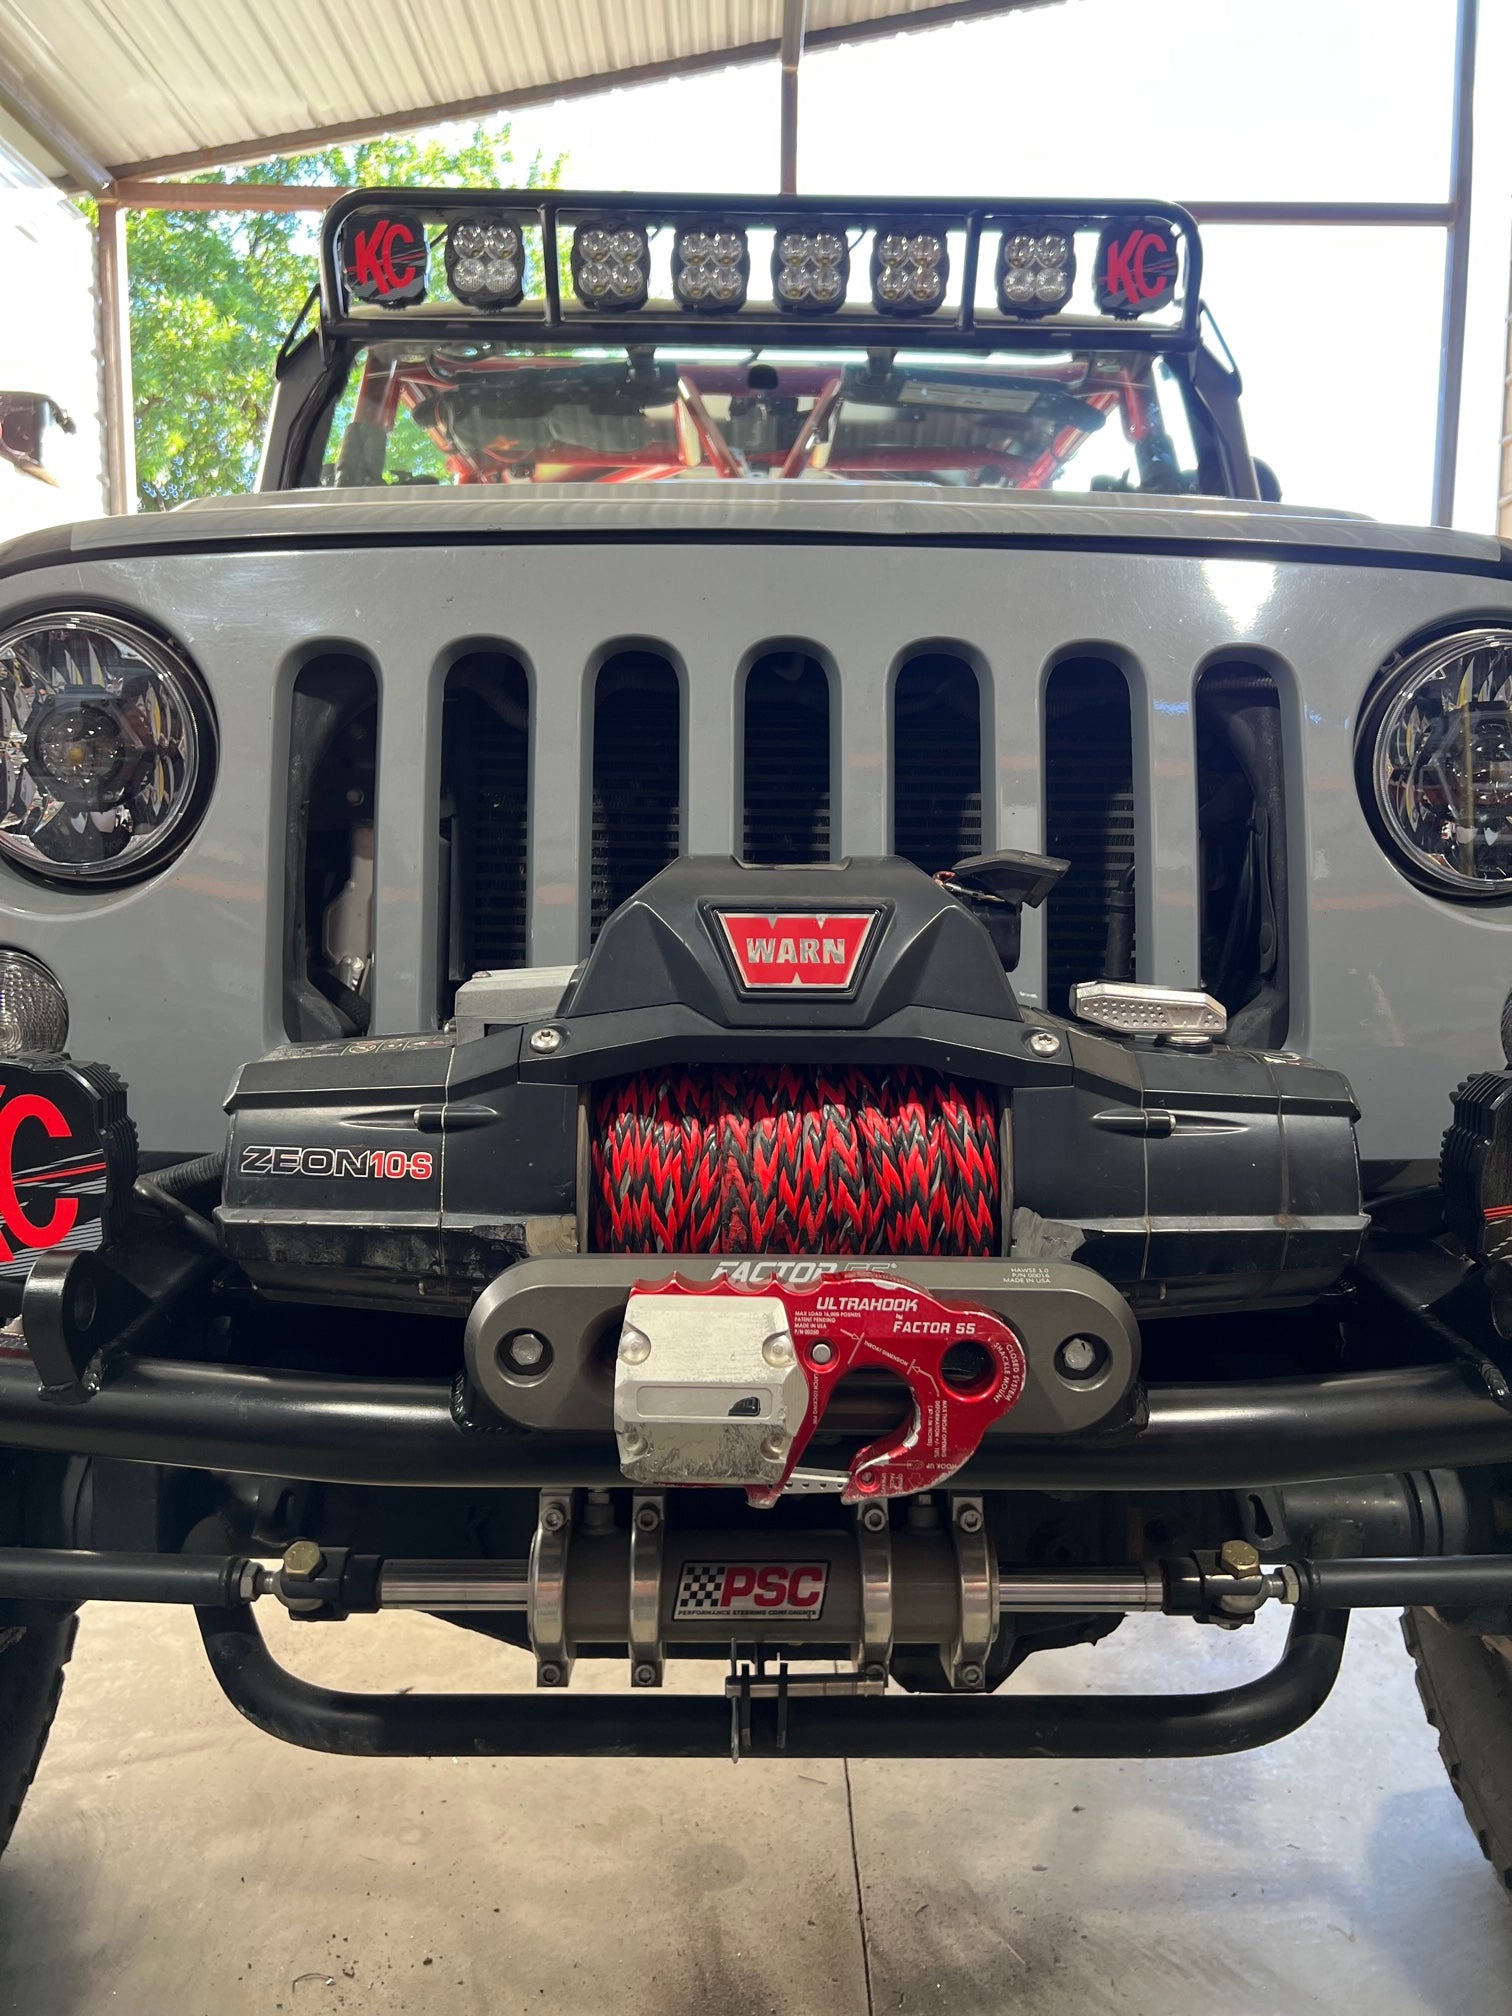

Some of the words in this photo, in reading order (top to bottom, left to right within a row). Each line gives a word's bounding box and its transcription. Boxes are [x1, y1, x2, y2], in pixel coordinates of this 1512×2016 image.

[354, 219, 417, 295] KC
[1107, 229, 1168, 305] KC
[745, 937, 846, 964] WARN
[0, 1085, 79, 1263] C
[816, 1296, 918, 1312] ULTRAHOOK
[893, 1320, 950, 1334] FACTOR
[955, 1322, 976, 1335] 55
[993, 1342, 1011, 1375] SHACKLE
[1006, 1344, 1020, 1373] CLOSED
[993, 1375, 1010, 1403] MOUNT
[1004, 1374, 1020, 1402] SYSTEM
[936, 1462, 957, 1470] HOOK
[719, 1566, 823, 1607] PSC
